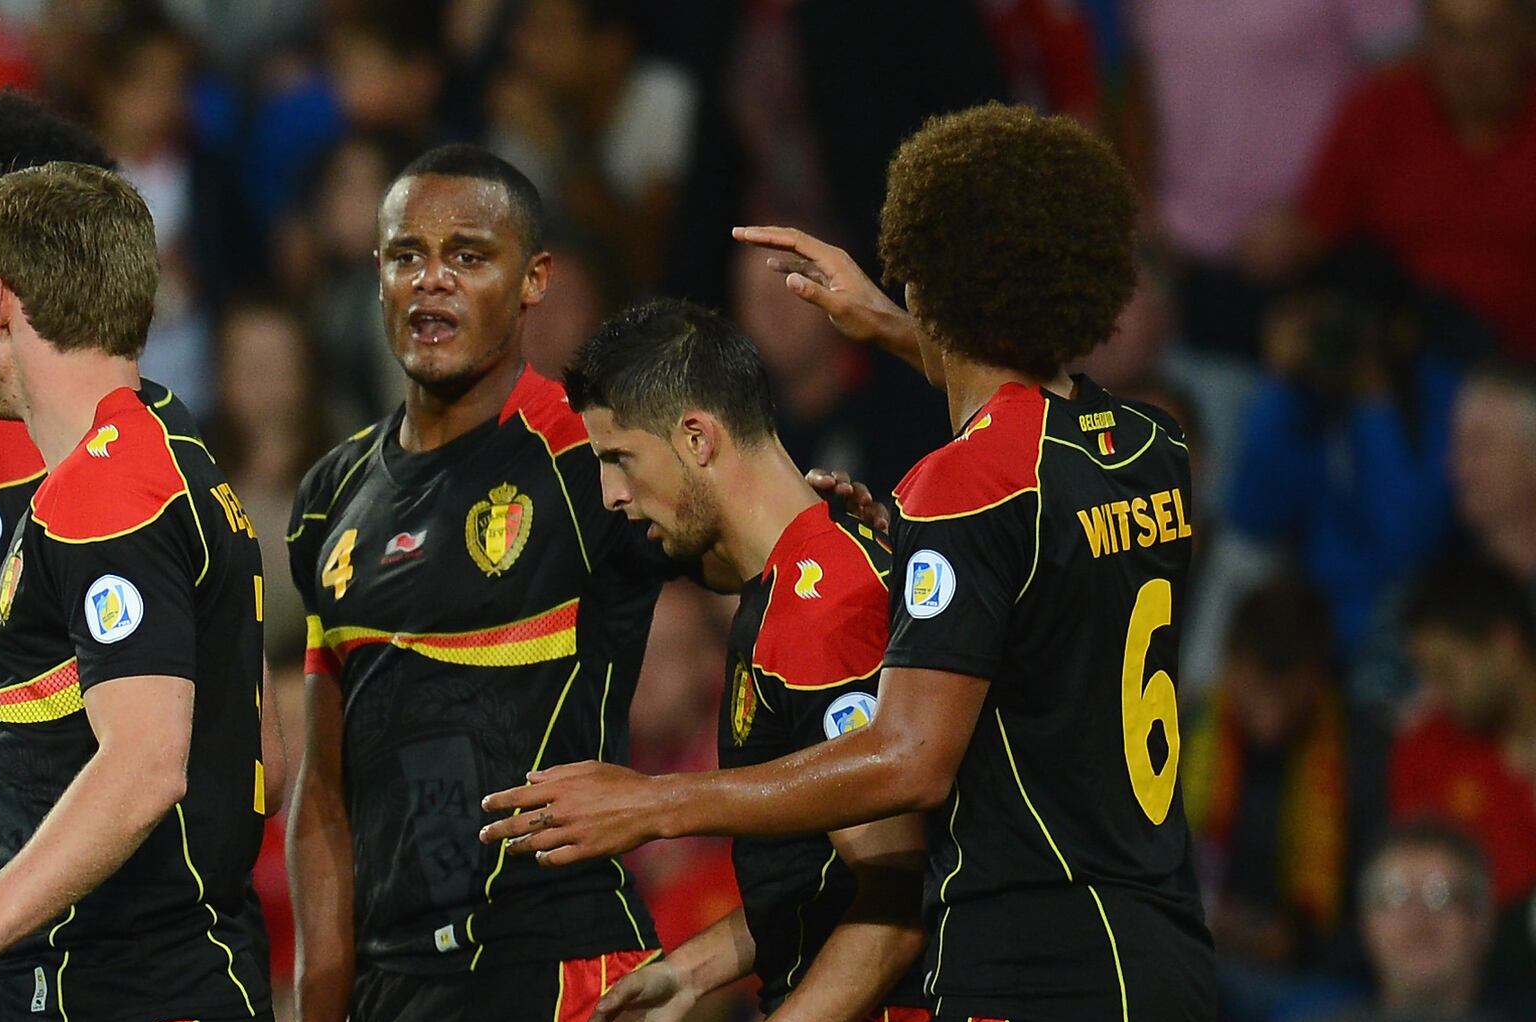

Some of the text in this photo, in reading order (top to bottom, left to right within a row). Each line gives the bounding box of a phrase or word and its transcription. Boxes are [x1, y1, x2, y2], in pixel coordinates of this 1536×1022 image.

[1076, 488, 1192, 558] WITSEL
[322, 528, 357, 600] 4
[1121, 578, 1181, 826] 6
